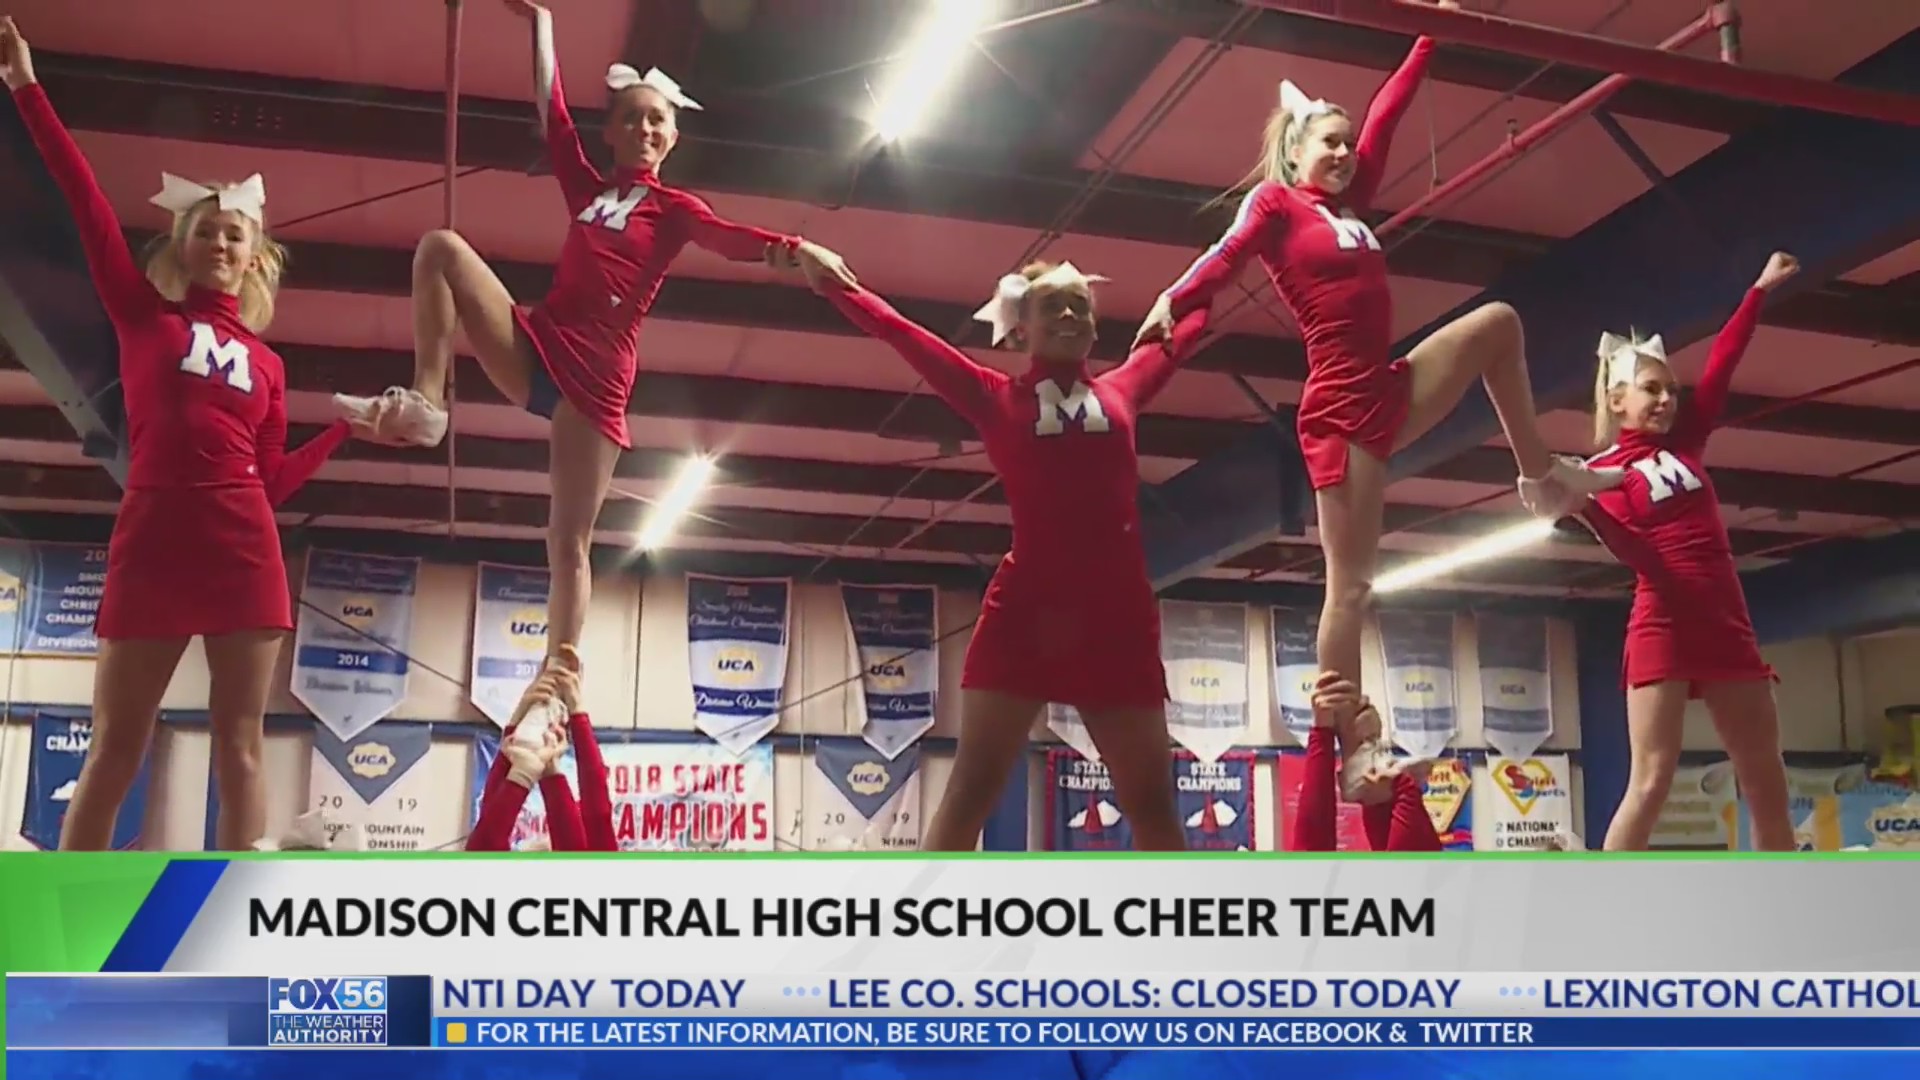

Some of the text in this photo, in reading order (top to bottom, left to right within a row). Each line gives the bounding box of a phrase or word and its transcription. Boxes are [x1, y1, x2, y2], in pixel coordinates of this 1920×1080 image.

[577, 187, 650, 231] M
[1315, 203, 1382, 251] M
[181, 321, 253, 394] M
[1035, 378, 1110, 436] M
[1630, 450, 1702, 503] M
[343, 606, 374, 618] UCA
[337, 654, 370, 667] 2014
[718, 659, 755, 671] UCA
[870, 664, 905, 677] UCA
[1190, 676, 1221, 688] UCA
[354, 754, 388, 765] UCA
[606, 765, 745, 793] 018 STATE
[853, 773, 883, 784] UCA
[1177, 776, 1242, 791] CHAMPIONS
[824, 812, 845, 825] 20
[1506, 822, 1559, 833] NATIONA
